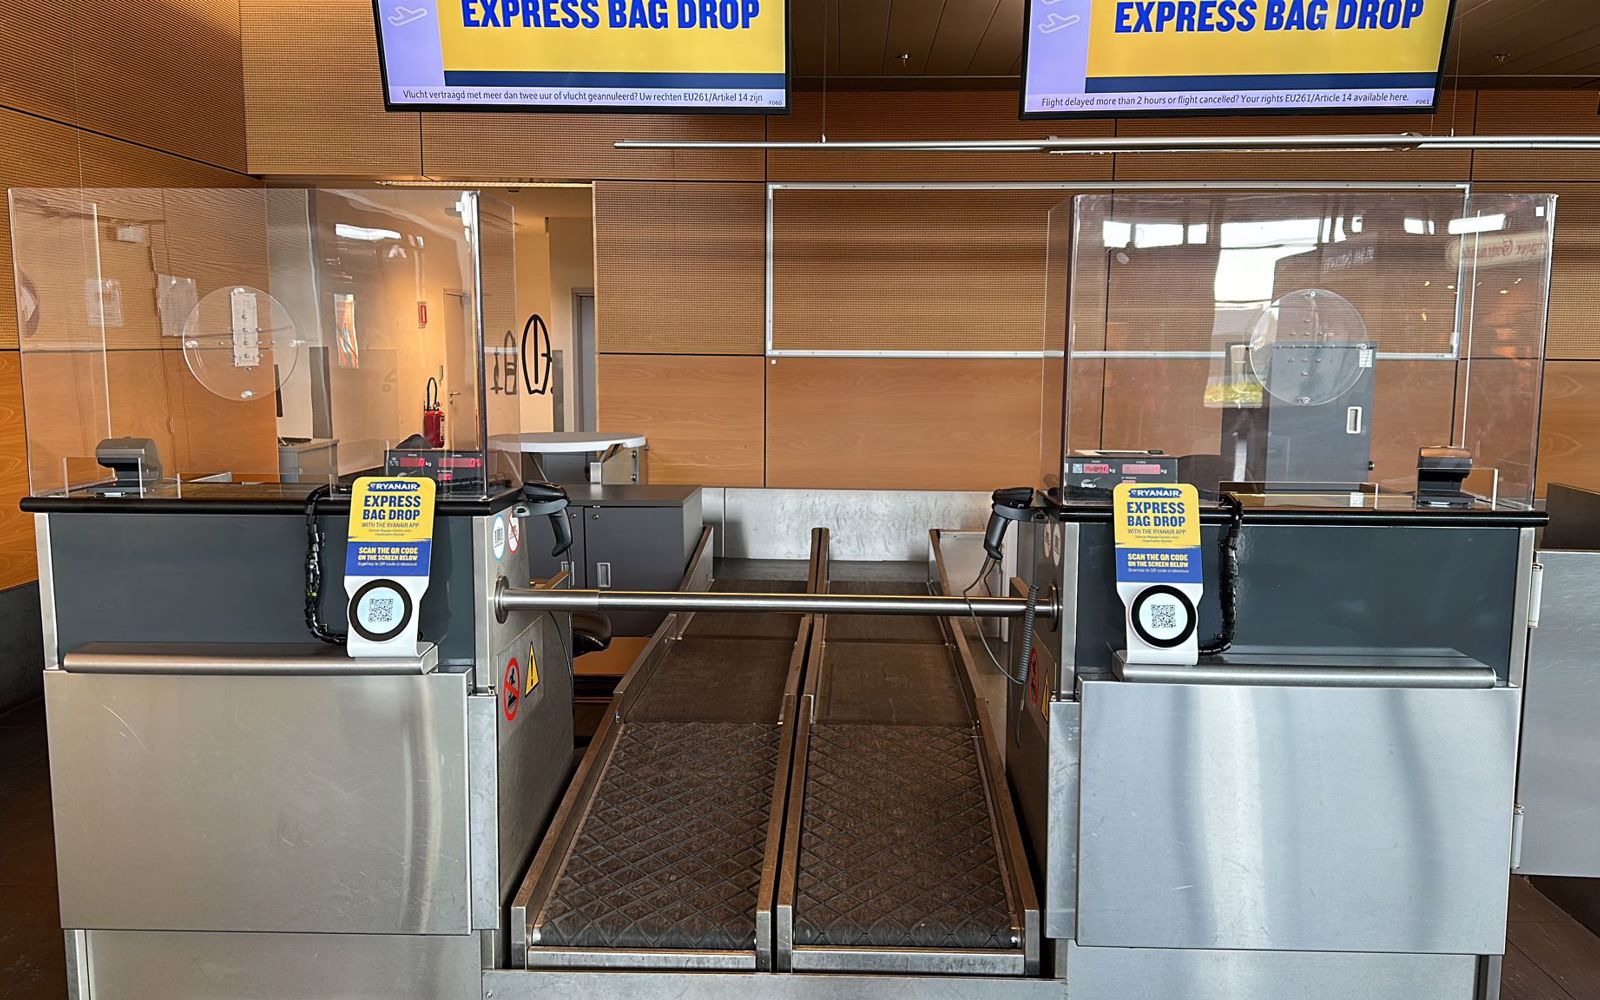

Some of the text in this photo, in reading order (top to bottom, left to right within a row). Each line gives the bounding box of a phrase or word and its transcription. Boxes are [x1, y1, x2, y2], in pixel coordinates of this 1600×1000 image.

[461, 0, 760, 29] EXPRESS BAG DROP
[1115, 0, 1424, 33] EXPRESS BAG DROP
[403, 89, 428, 98] Vlucht
[429, 90, 465, 101] vertraagd
[467, 91, 482, 99] met
[504, 91, 518, 99] dan
[519, 92, 538, 100] twee
[553, 91, 562, 100] of
[563, 91, 587, 100] vlucht
[588, 92, 638, 103] geannuleerd?
[639, 93, 653, 101] Uw
[653, 92, 681, 101] rechten
[683, 92, 737, 102] EU261/Artikel
[738, 93, 748, 101] 14
[749, 93, 763, 104] zijn
[1041, 97, 1063, 108] Flight
[1065, 96, 1094, 107] delayed
[1118, 97, 1135, 105] than
[1143, 96, 1166, 104] hours
[1177, 95, 1198, 106] flight
[1199, 94, 1239, 103] cancelled?
[1241, 94, 1259, 103] Your
[1261, 94, 1284, 105] rights
[1285, 93, 1340, 102] EU261/Article
[1342, 93, 1352, 102] 14
[1353, 92, 1388, 102] available
[1390, 92, 1409, 101] here.
[364, 495, 422, 508] EXPRESS
[1127, 502, 1185, 514] EXPRESS
[363, 509, 421, 521] BAG DROP
[1127, 516, 1186, 527] BAG DROP
[1128, 553, 1146, 561] SCAN
[1146, 553, 1160, 561] THE
